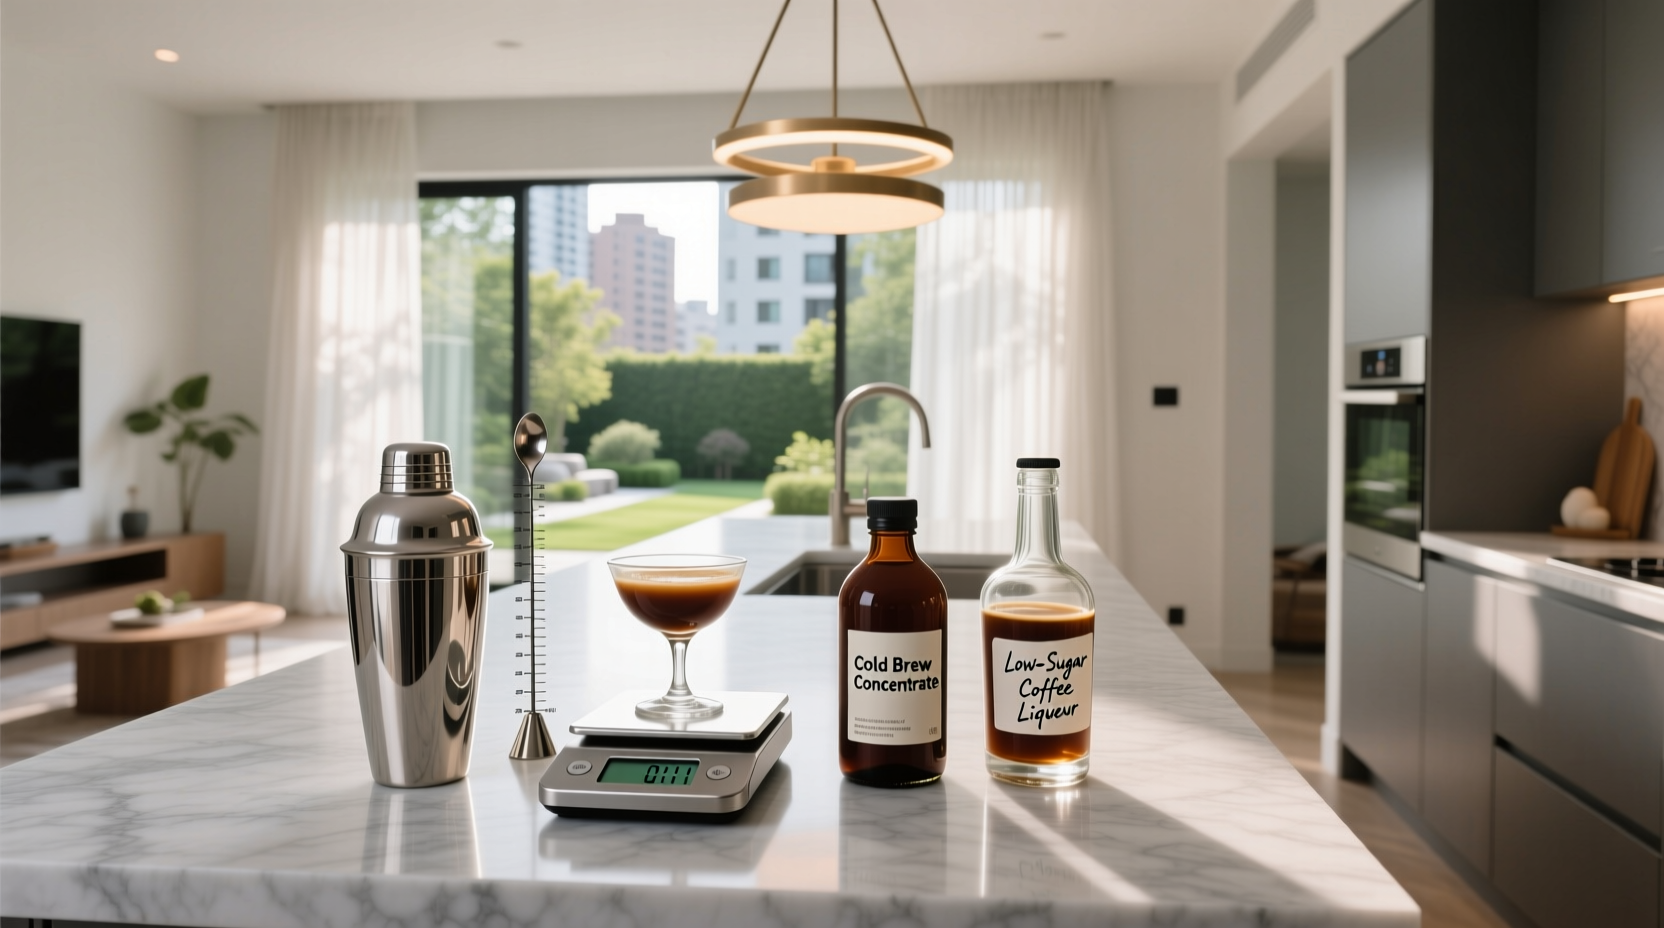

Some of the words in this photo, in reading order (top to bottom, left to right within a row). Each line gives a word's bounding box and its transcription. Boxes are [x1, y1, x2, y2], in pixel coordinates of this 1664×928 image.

[854, 655, 888, 673] Cold
[892, 656, 933, 673] Brew
[1004, 650, 1088, 680] Low-Sugar
[854, 674, 939, 692] Concentrate
[1019, 678, 1074, 704] Coffee
[1017, 701, 1079, 730] Liqueur
